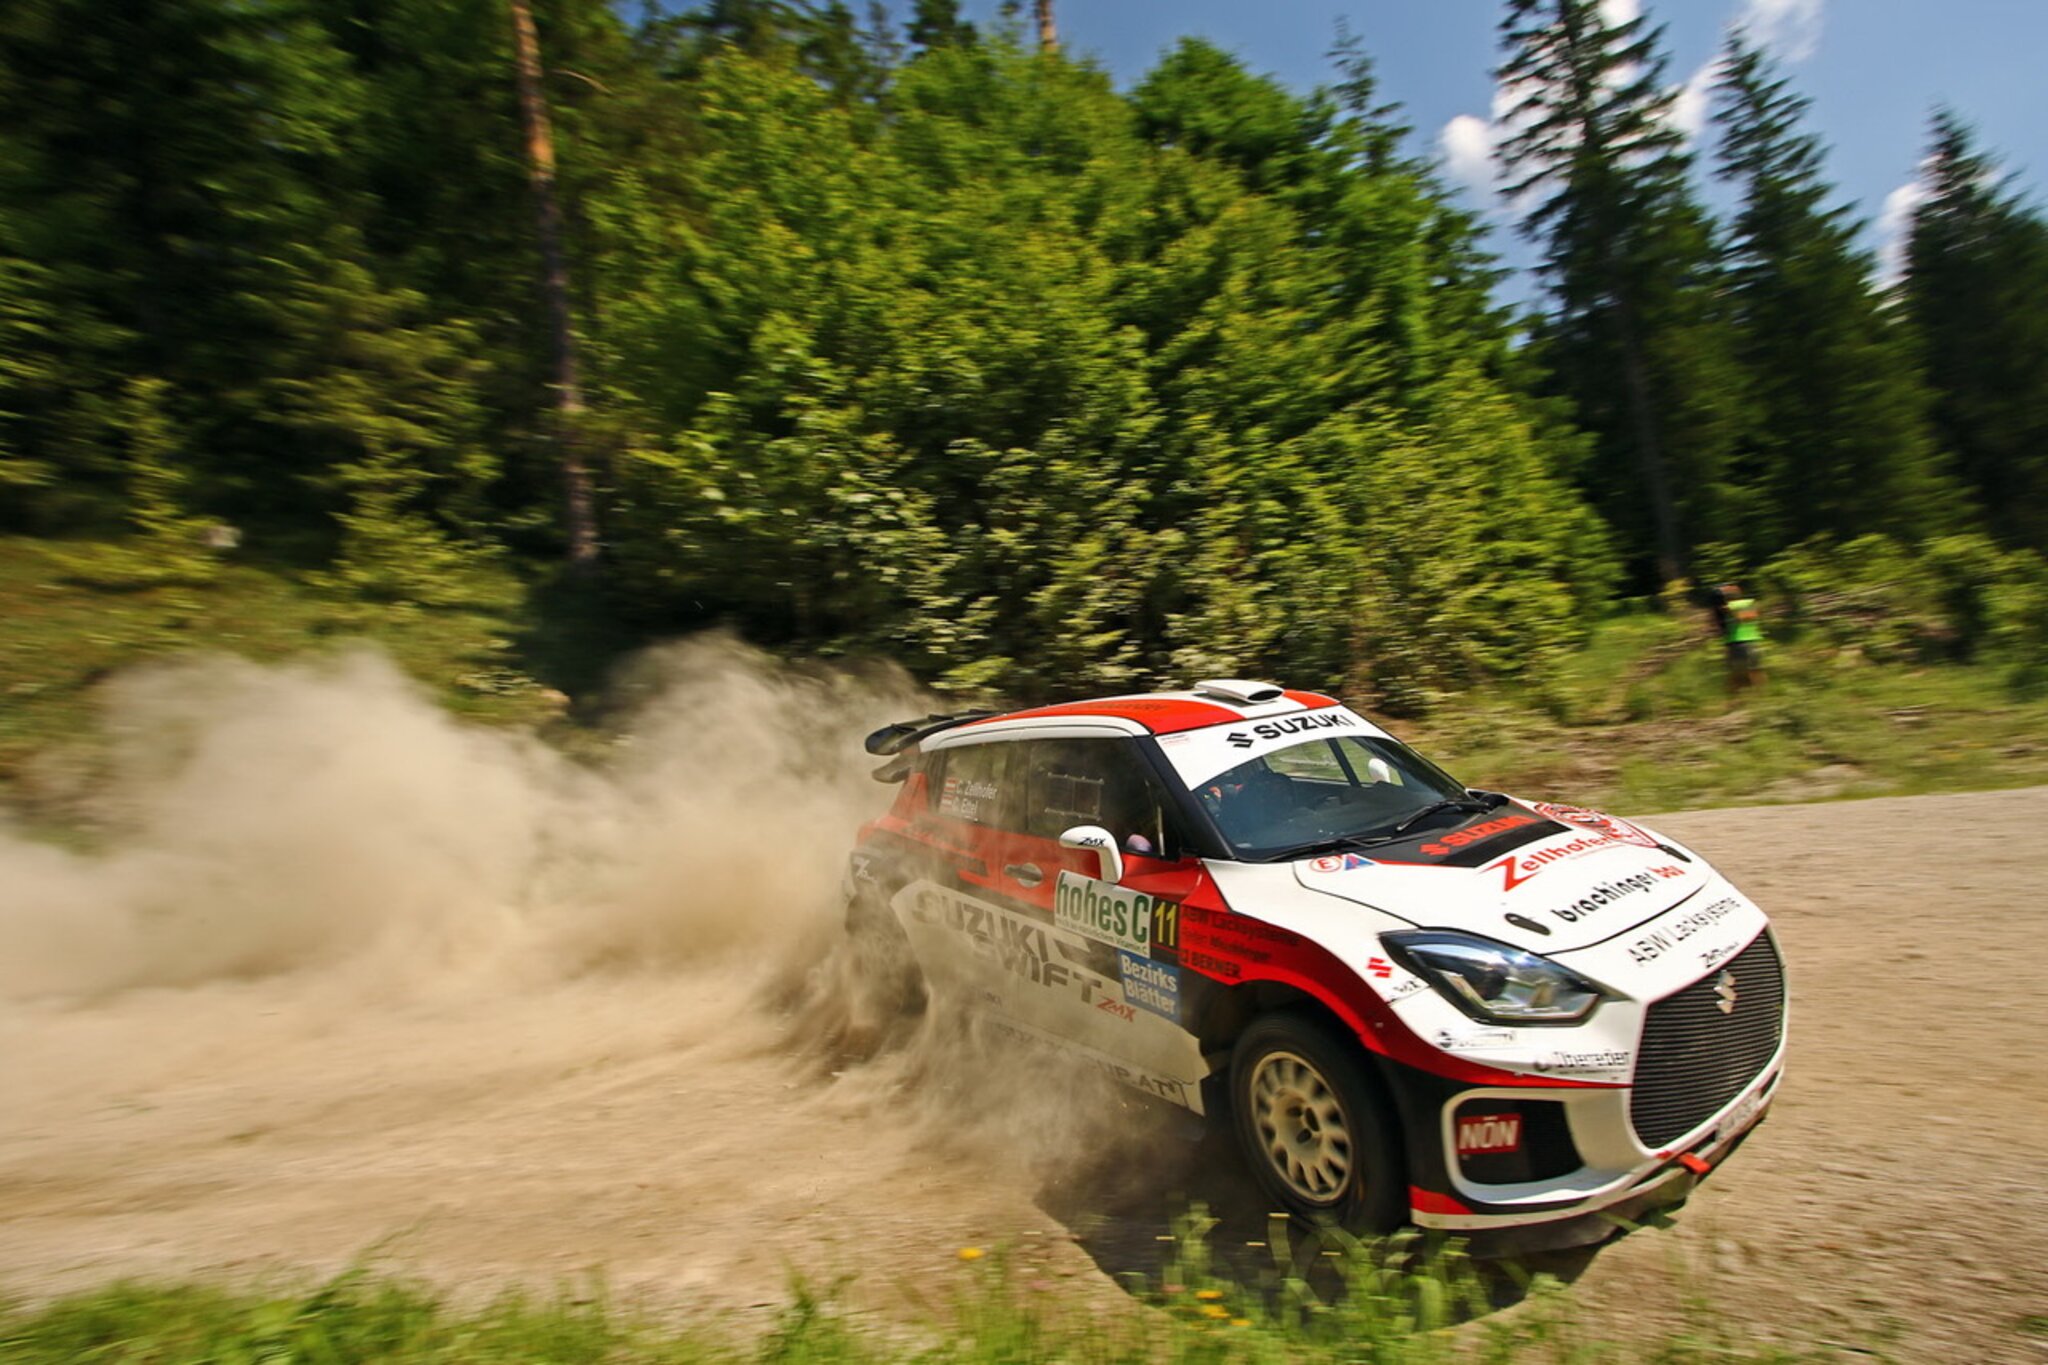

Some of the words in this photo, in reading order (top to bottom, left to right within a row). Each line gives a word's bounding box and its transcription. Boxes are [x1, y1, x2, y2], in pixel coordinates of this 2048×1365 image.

[1253, 714, 1355, 740] SUZUKI
[1440, 814, 1538, 848] SUZUKI
[1477, 834, 1613, 893] Zellhofer
[1056, 871, 1128, 937] hohes
[1132, 894, 1149, 944] C
[1549, 871, 1660, 923] brachinger
[911, 889, 1050, 964] SUZUKI
[1154, 901, 1178, 948] 11
[1121, 954, 1177, 993] Bezirks
[1124, 977, 1176, 1015] Blätter
